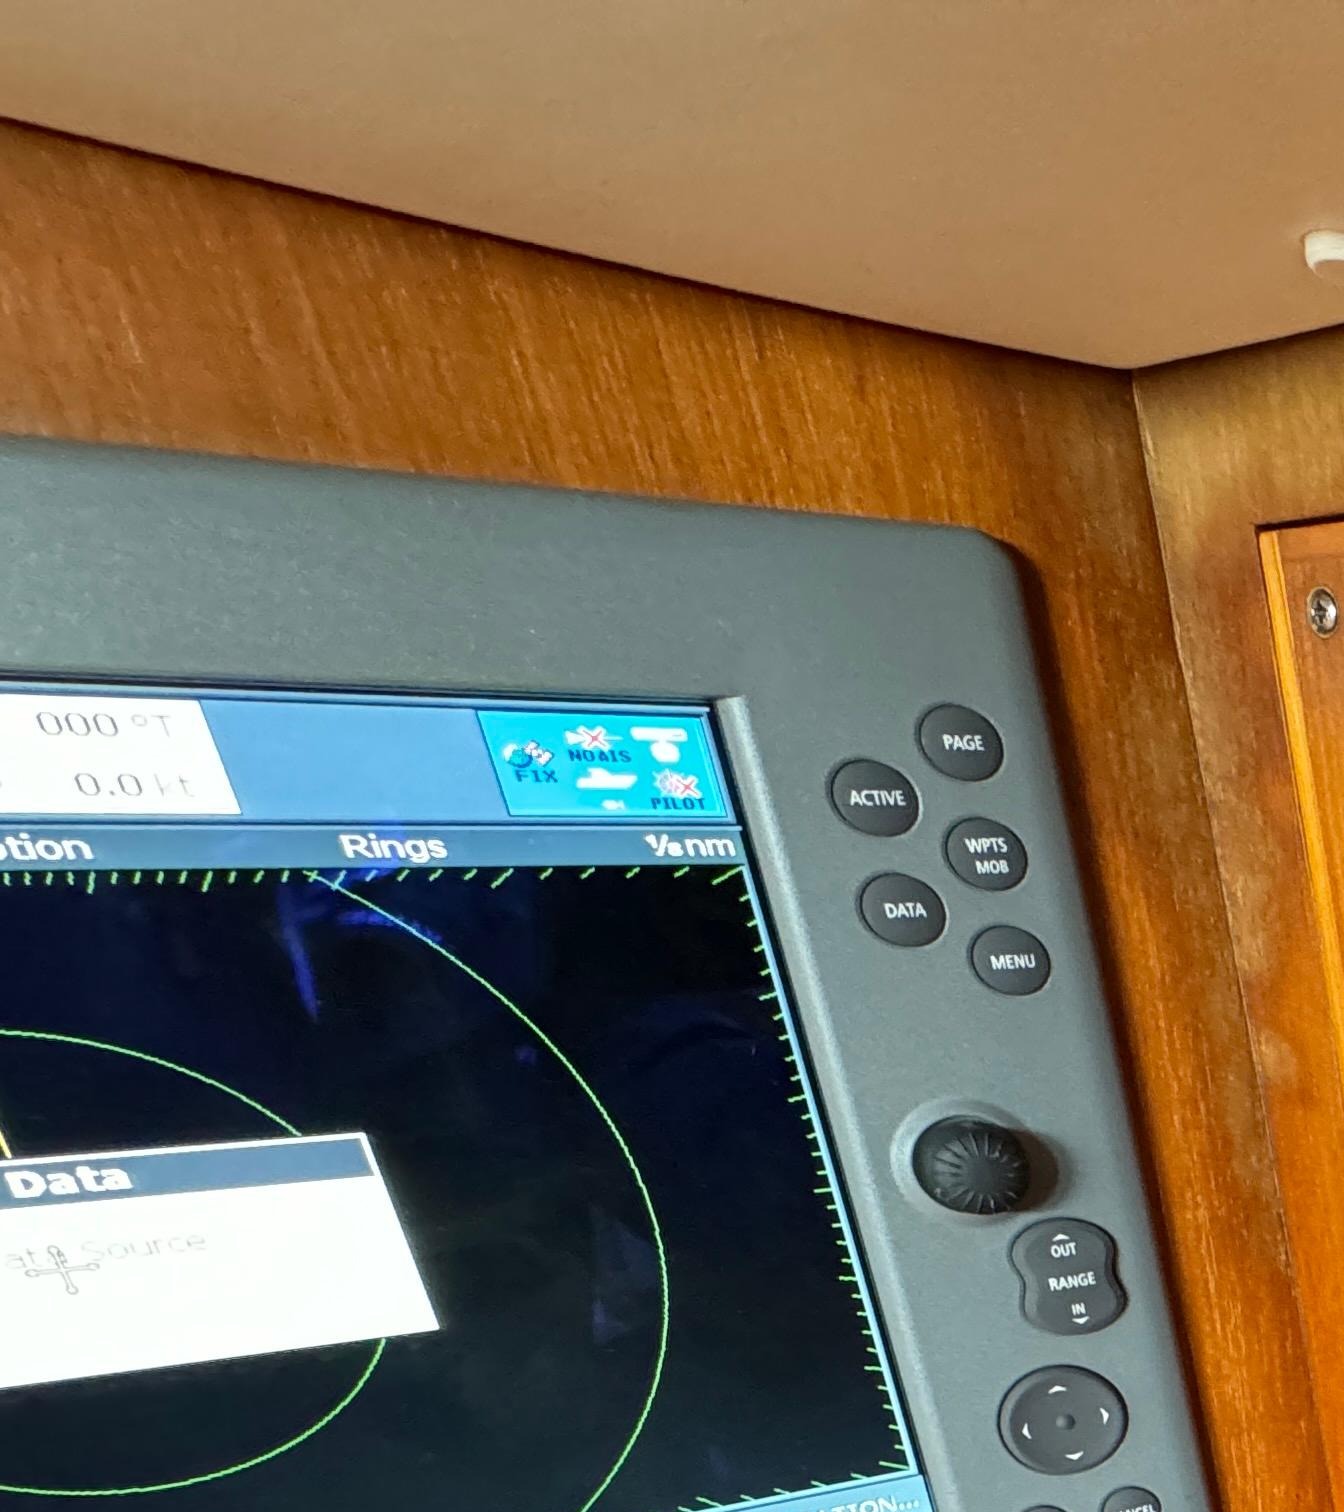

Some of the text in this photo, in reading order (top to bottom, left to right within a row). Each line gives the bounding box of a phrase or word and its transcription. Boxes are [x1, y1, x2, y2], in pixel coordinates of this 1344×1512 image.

[36, 711, 118, 737] 000
[942, 734, 984, 751] PAGE
[598, 750, 632, 763] AIS
[74, 772, 195, 797] 0.0 kt
[514, 768, 558, 784] FIX
[651, 797, 706, 810] PILOT
[850, 789, 907, 807] ACTIVE
[0, 833, 94, 860] tion
[339, 833, 448, 864] Rings
[965, 837, 1008, 854] WPTS
[975, 860, 1009, 875] MOB
[884, 902, 927, 919] DATA
[990, 953, 1036, 970] MENU
[4, 1166, 133, 1198] Data
[1050, 1241, 1077, 1258] OUT
[1048, 1271, 1097, 1292] RANGE
[1071, 1302, 1086, 1316] IN
